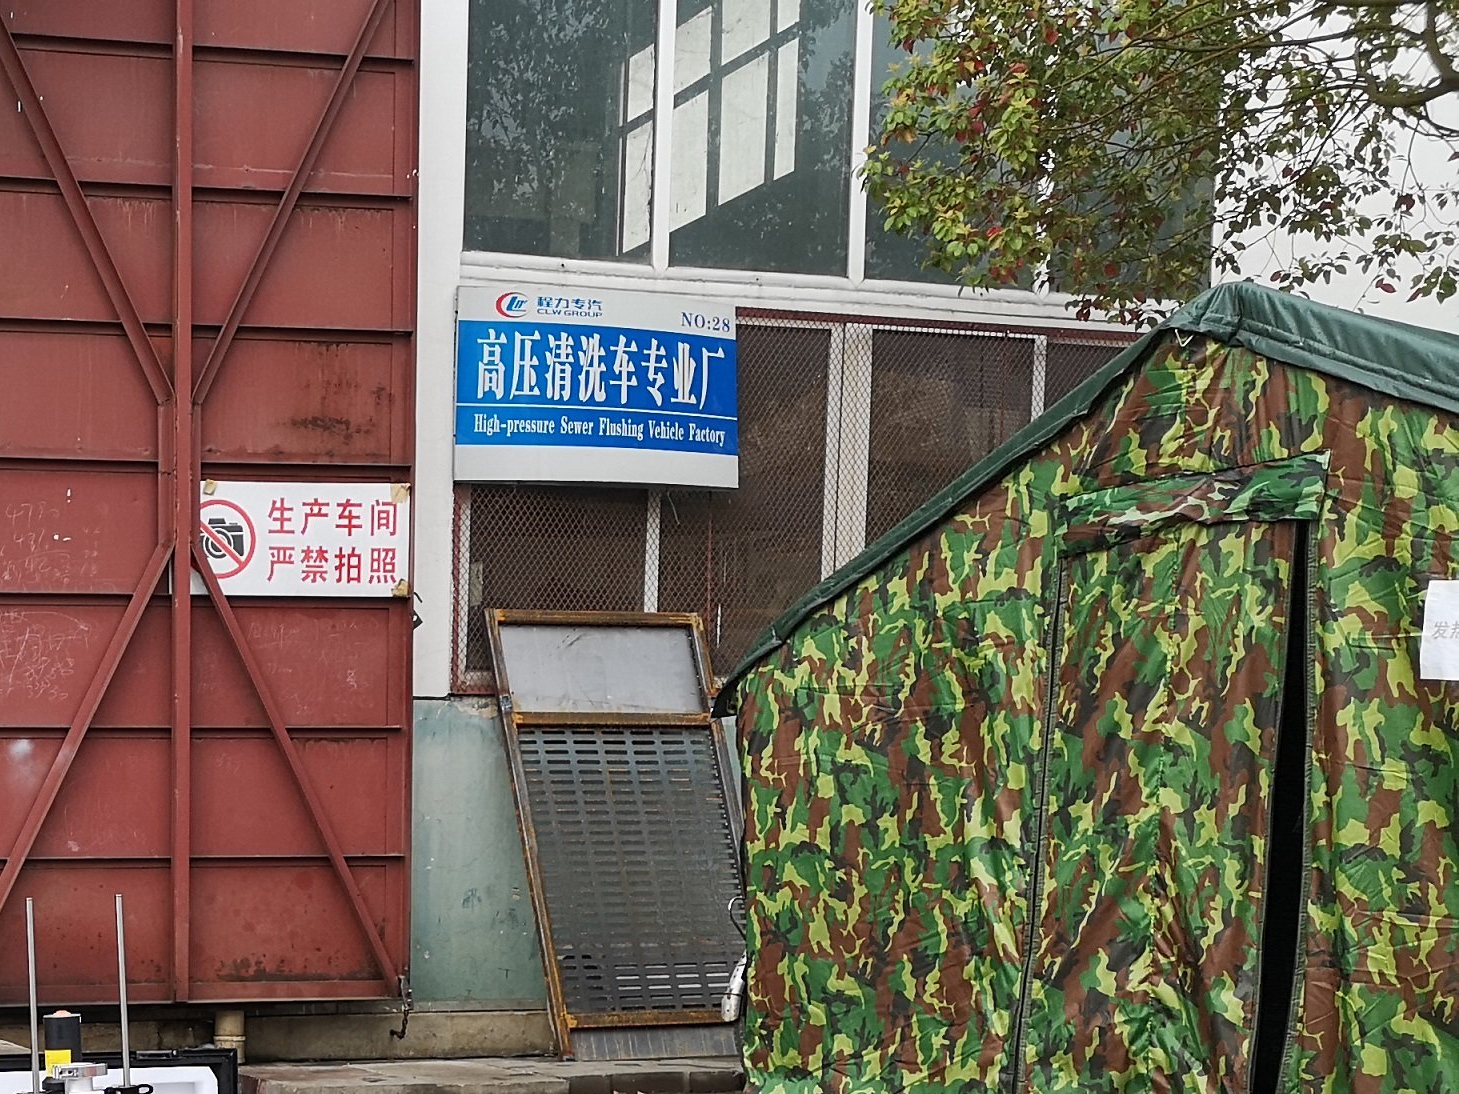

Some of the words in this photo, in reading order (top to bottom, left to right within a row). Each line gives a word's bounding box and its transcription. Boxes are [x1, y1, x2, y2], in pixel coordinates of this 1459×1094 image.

[537, 296, 603, 311] 程力专汽
[537, 308, 562, 316] CLW
[564, 309, 603, 318] GROUP
[681, 311, 731, 333] NO:28
[476, 328, 726, 410] 高压清洗车专业厂
[473, 413, 555, 437] High-pressure
[560, 416, 594, 435] Sewer
[599, 417, 643, 440] Flushing
[648, 420, 685, 440] Vehicle
[689, 423, 726, 447] Factory
[267, 497, 398, 537] 生产车间
[266, 546, 398, 585] 严禁拍照
